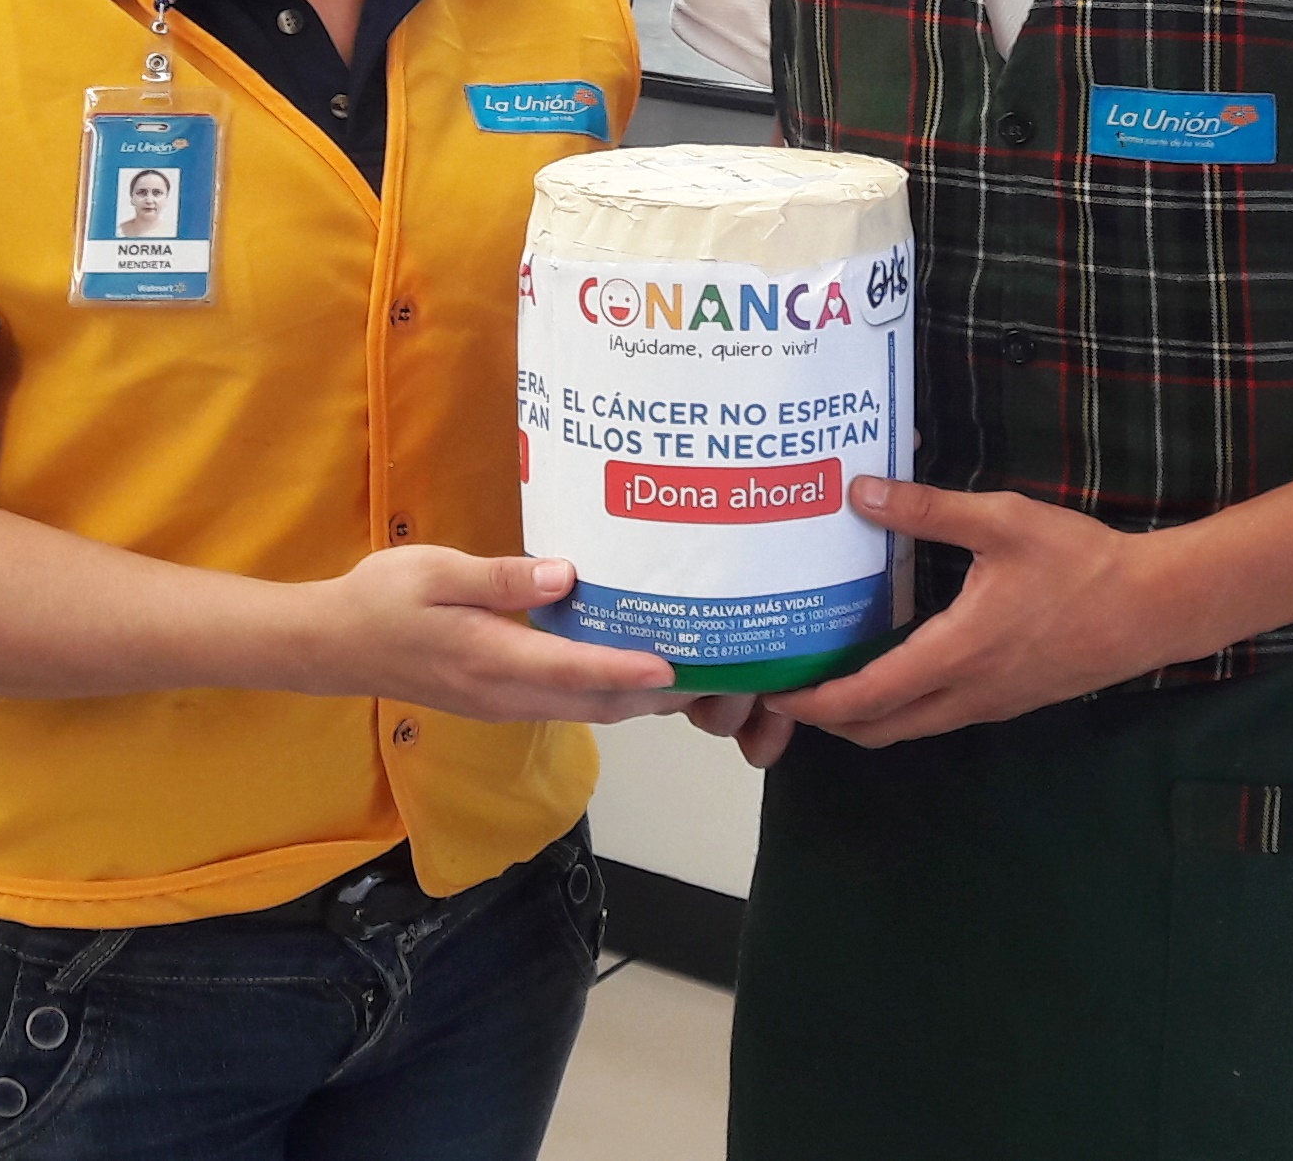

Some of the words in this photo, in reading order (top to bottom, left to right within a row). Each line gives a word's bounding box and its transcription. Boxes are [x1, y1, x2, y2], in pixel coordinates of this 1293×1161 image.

[485, 95, 510, 112] La
[514, 94, 576, 112] Unión
[1107, 104, 1140, 128] La
[1142, 108, 1222, 134] Unión
[120, 142, 135, 153] La
[138, 141, 173, 153] Unión
[117, 243, 173, 257] NORMA
[117, 260, 173, 270] MENDIETA
[578, 276, 853, 332] CONANCA
[609, 334, 703, 360] ¡Ayúdame,
[712, 342, 774, 362] quiero
[780, 337, 819, 358] vivir!
[518, 371, 551, 403] ERA,
[563, 387, 586, 414] EL
[592, 391, 709, 426] CÁNCER
[719, 402, 768, 427] NO
[778, 389, 881, 426] ESPERA,
[518, 399, 550, 432] TAN
[562, 418, 644, 455] ELLOS
[659, 432, 694, 459] TE
[707, 417, 879, 460] NECESITAN
[625, 475, 719, 512] ¡Dona
[729, 472, 825, 510] ahora!
[689, 605, 699, 618] A
[702, 604, 752, 618] SALVAR
[755, 598, 782, 613] MÁS
[784, 595, 825, 611] VIDAS!
